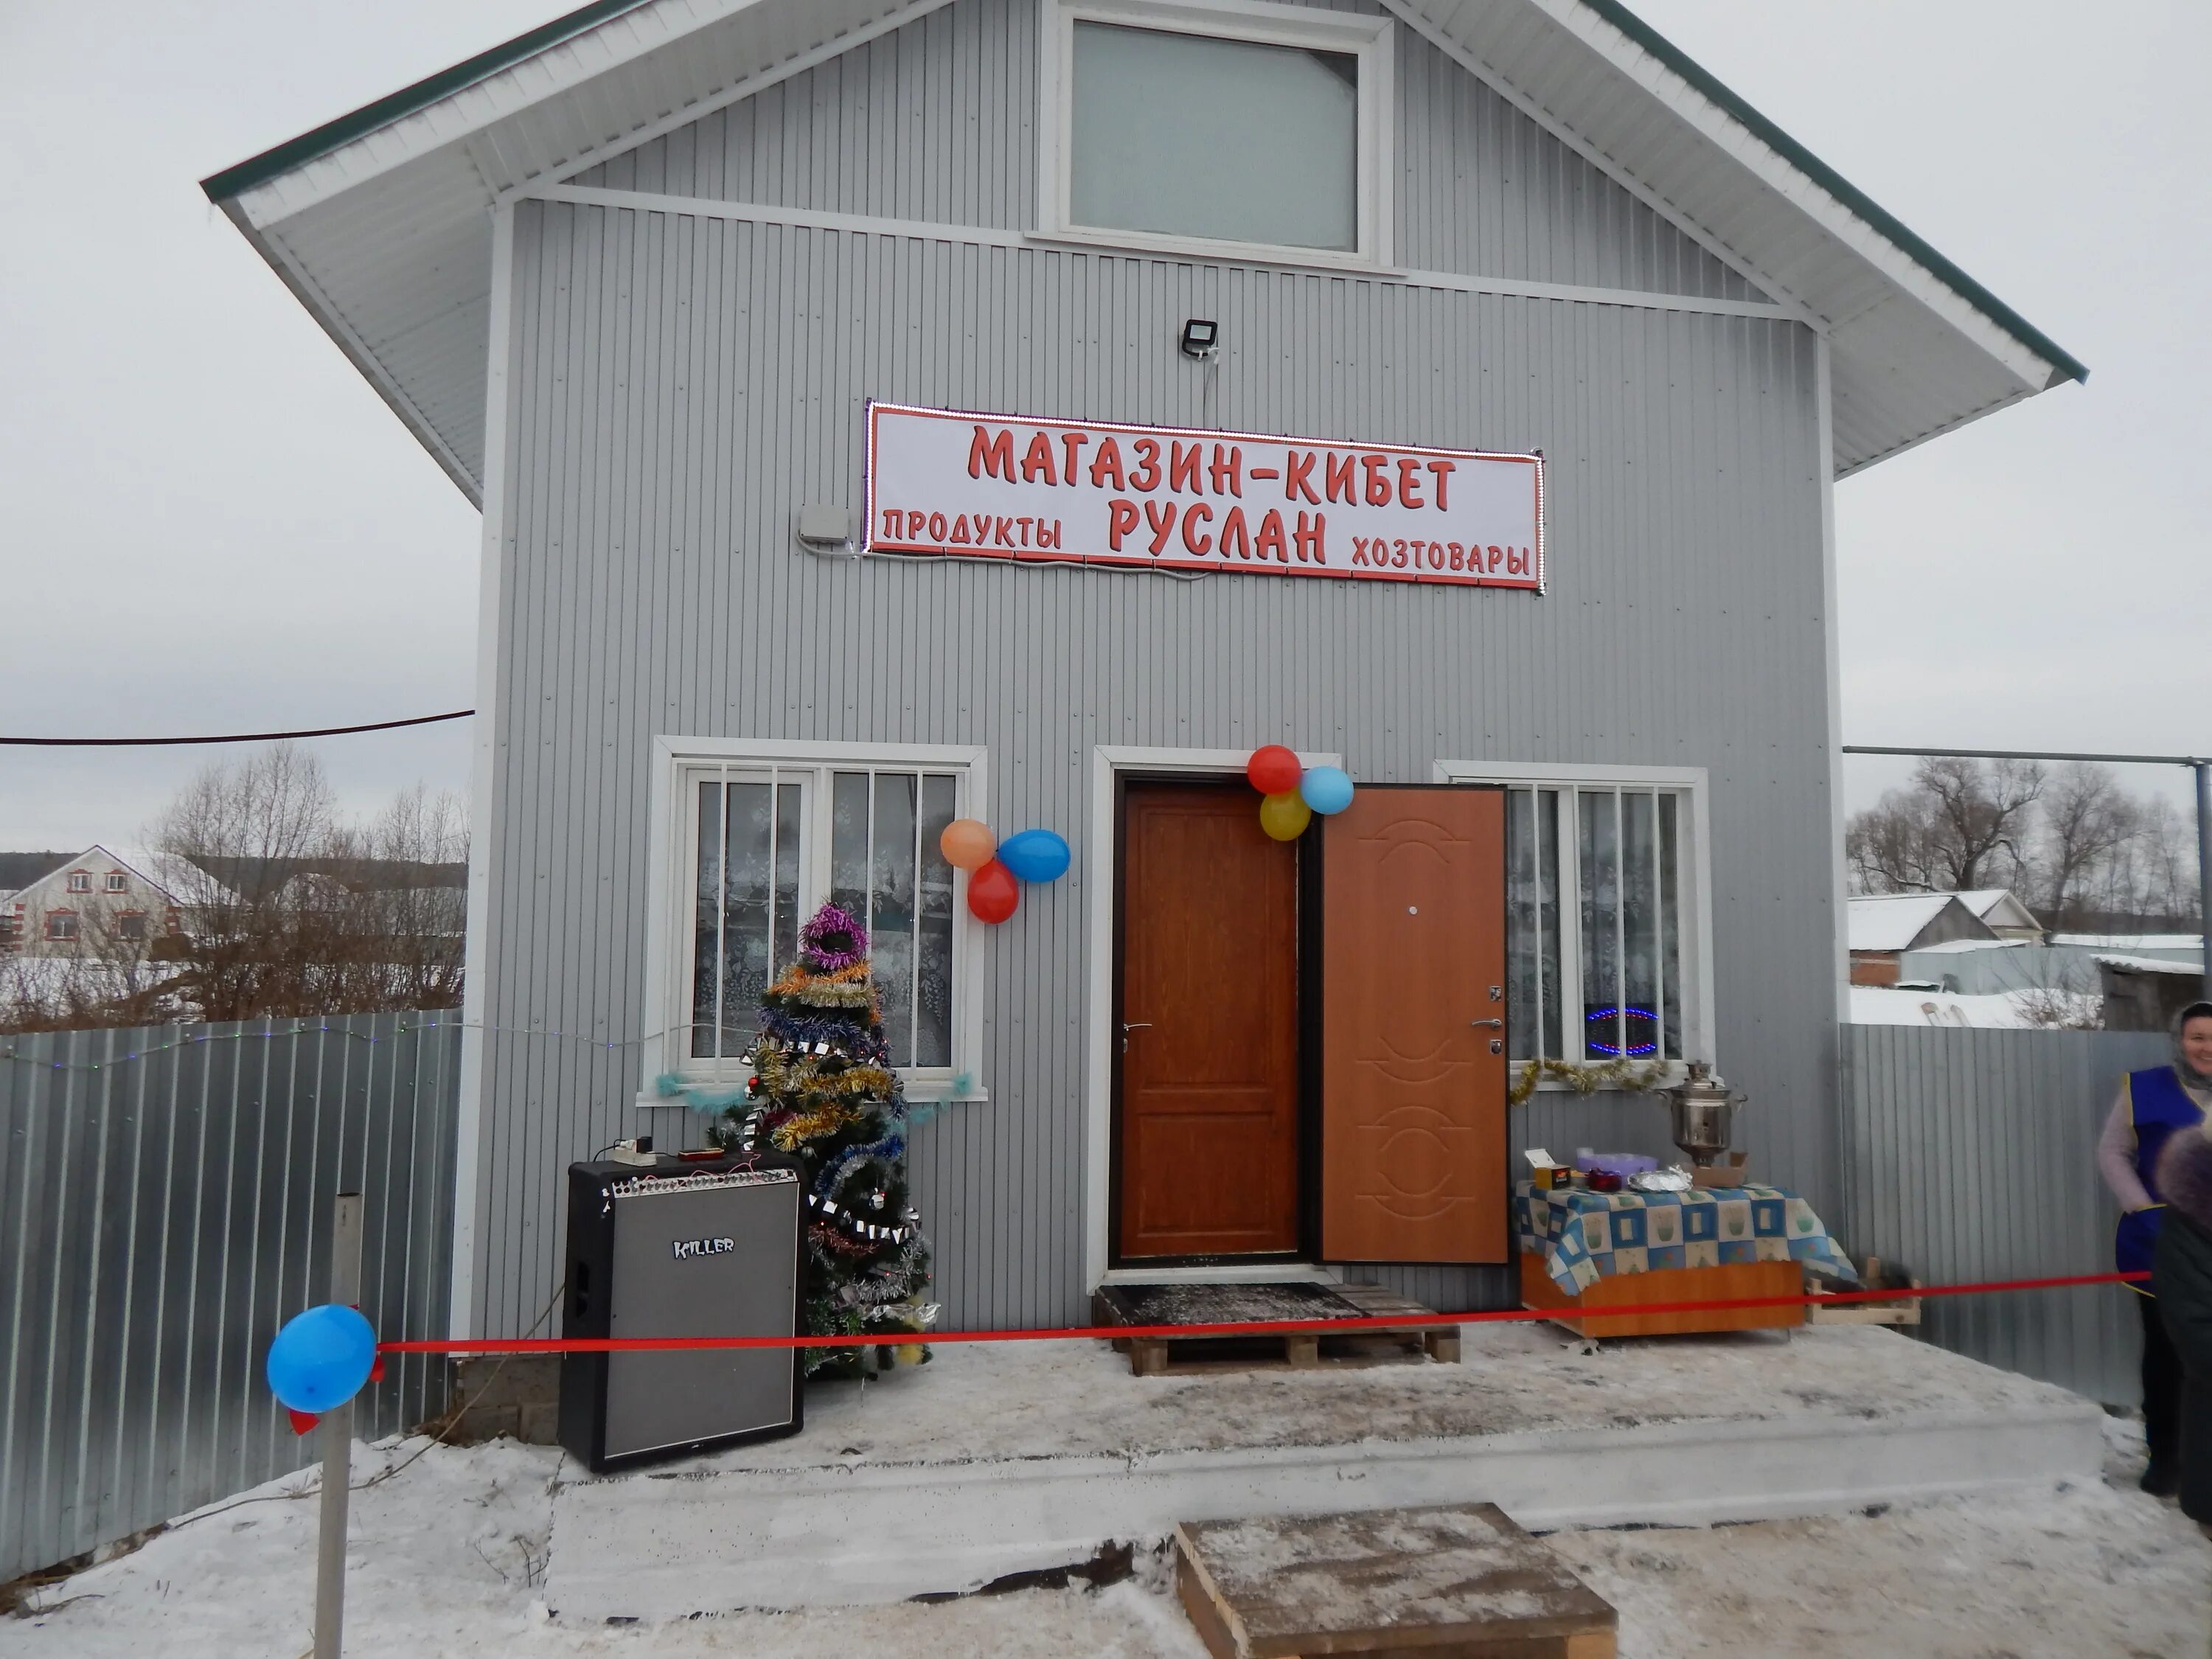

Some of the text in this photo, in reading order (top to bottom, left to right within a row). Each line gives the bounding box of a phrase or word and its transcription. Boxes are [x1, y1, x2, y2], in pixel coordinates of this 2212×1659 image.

[967, 425, 1456, 510] МАГАЗИН-КИБЕТ
[883, 509, 1062, 549] ПРОДУКТЫ
[1109, 498, 1326, 565] РУСЛАН
[1352, 538, 1529, 574] ХОЗТОВАРЫ
[673, 1237, 735, 1259] KILLER
